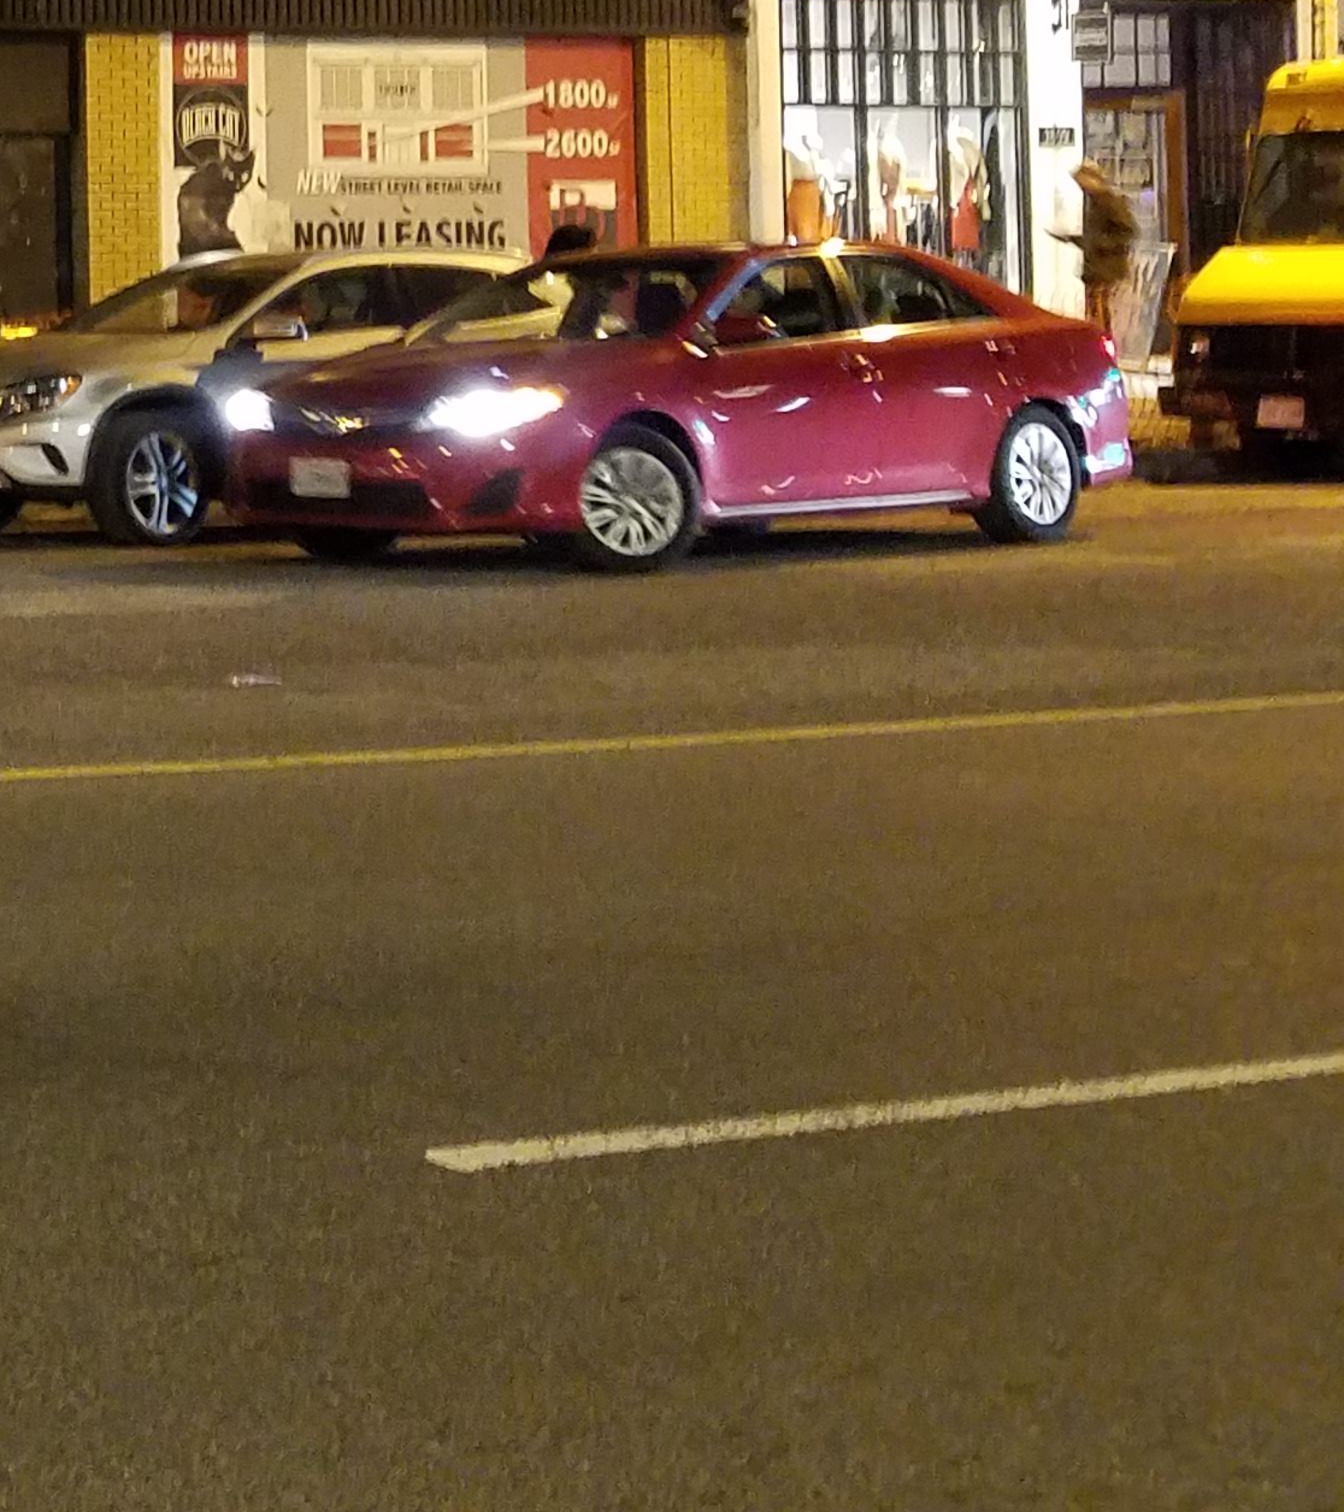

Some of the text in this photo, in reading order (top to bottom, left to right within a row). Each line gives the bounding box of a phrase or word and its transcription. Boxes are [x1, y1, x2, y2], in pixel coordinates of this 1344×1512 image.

[183, 40, 237, 65] OPEN
[545, 78, 607, 110] 1800
[545, 128, 609, 159] 2600
[296, 169, 341, 196] NEW
[340, 178, 383, 195] STREET
[387, 178, 420, 195] LEVEL
[293, 219, 507, 251] NOW LEASING
